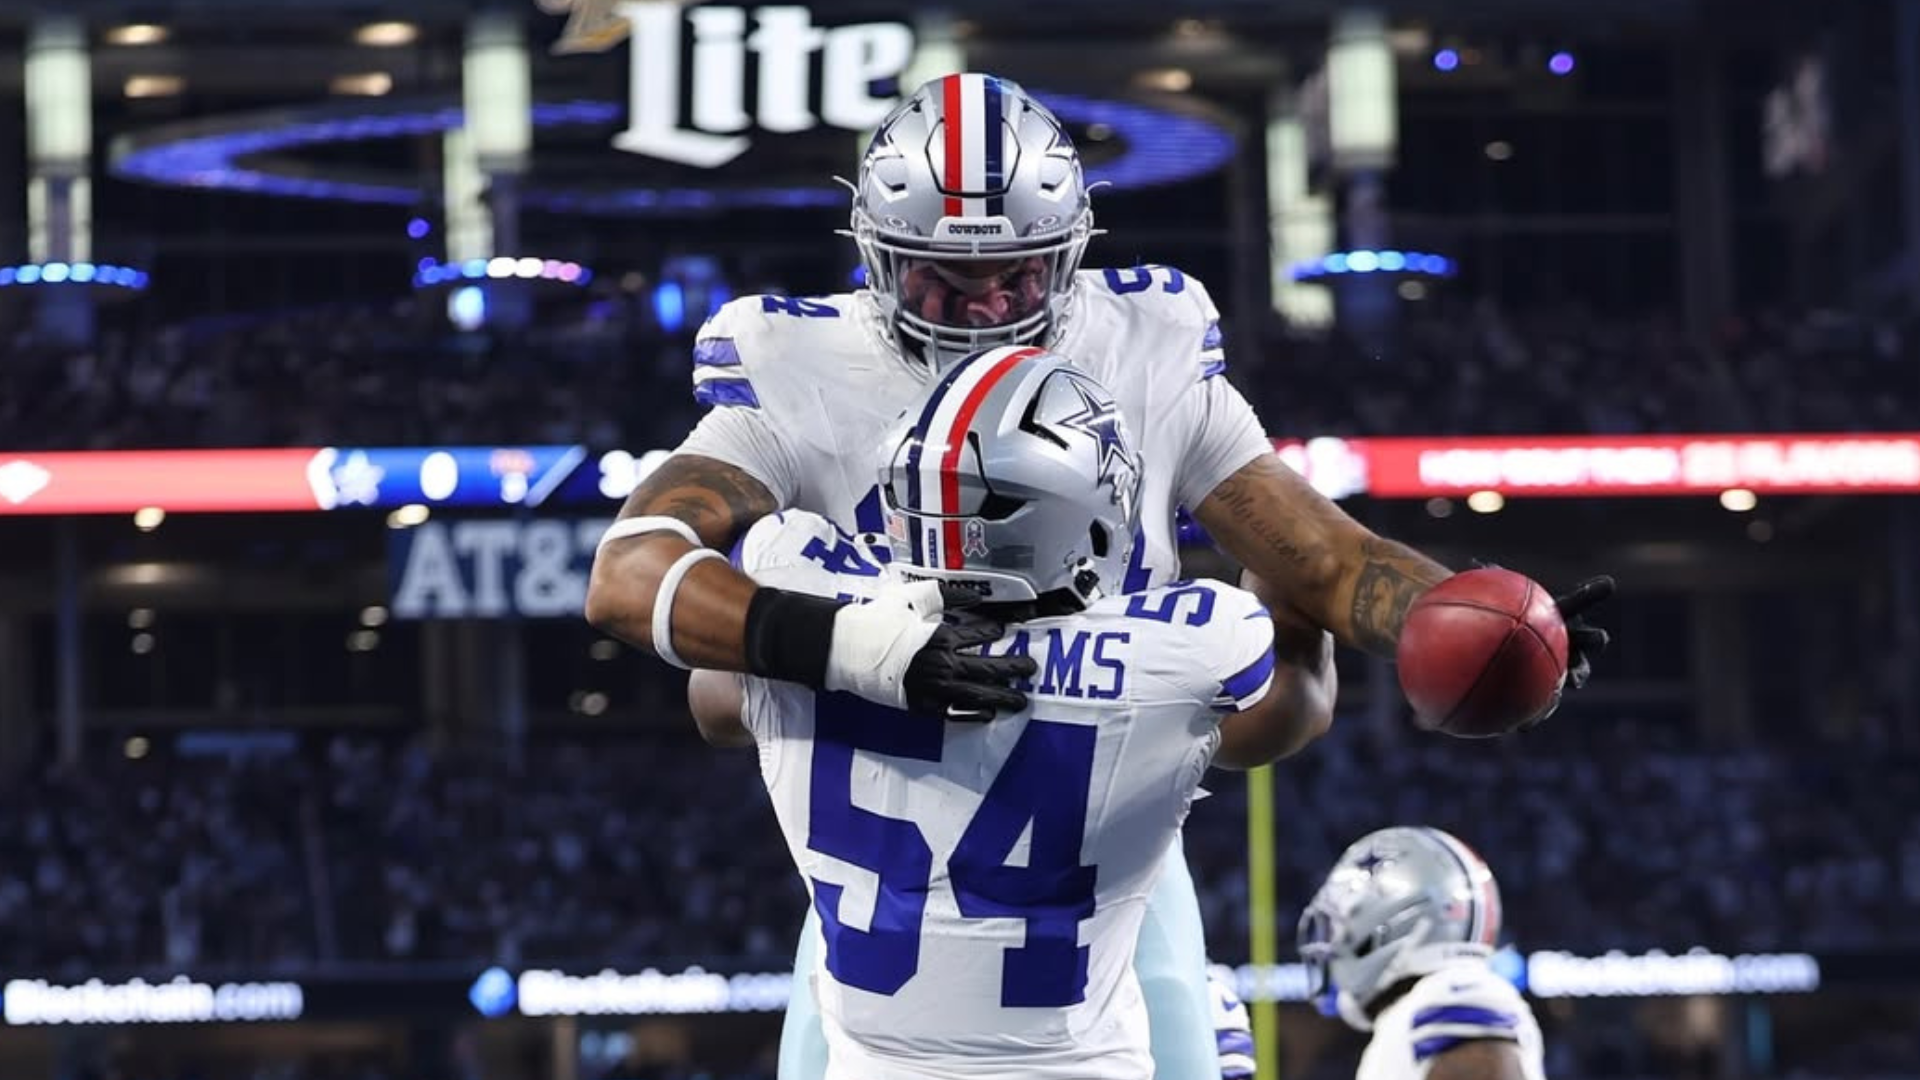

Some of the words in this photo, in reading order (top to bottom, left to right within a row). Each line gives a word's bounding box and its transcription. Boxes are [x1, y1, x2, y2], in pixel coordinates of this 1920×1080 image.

[611, 2, 914, 168] Lite
[948, 223, 1001, 235] COWBOYS
[800, 520, 881, 577] 4
[1124, 580, 1217, 627] 5
[979, 628, 1130, 699] AMS
[806, 688, 1099, 1008] 54
